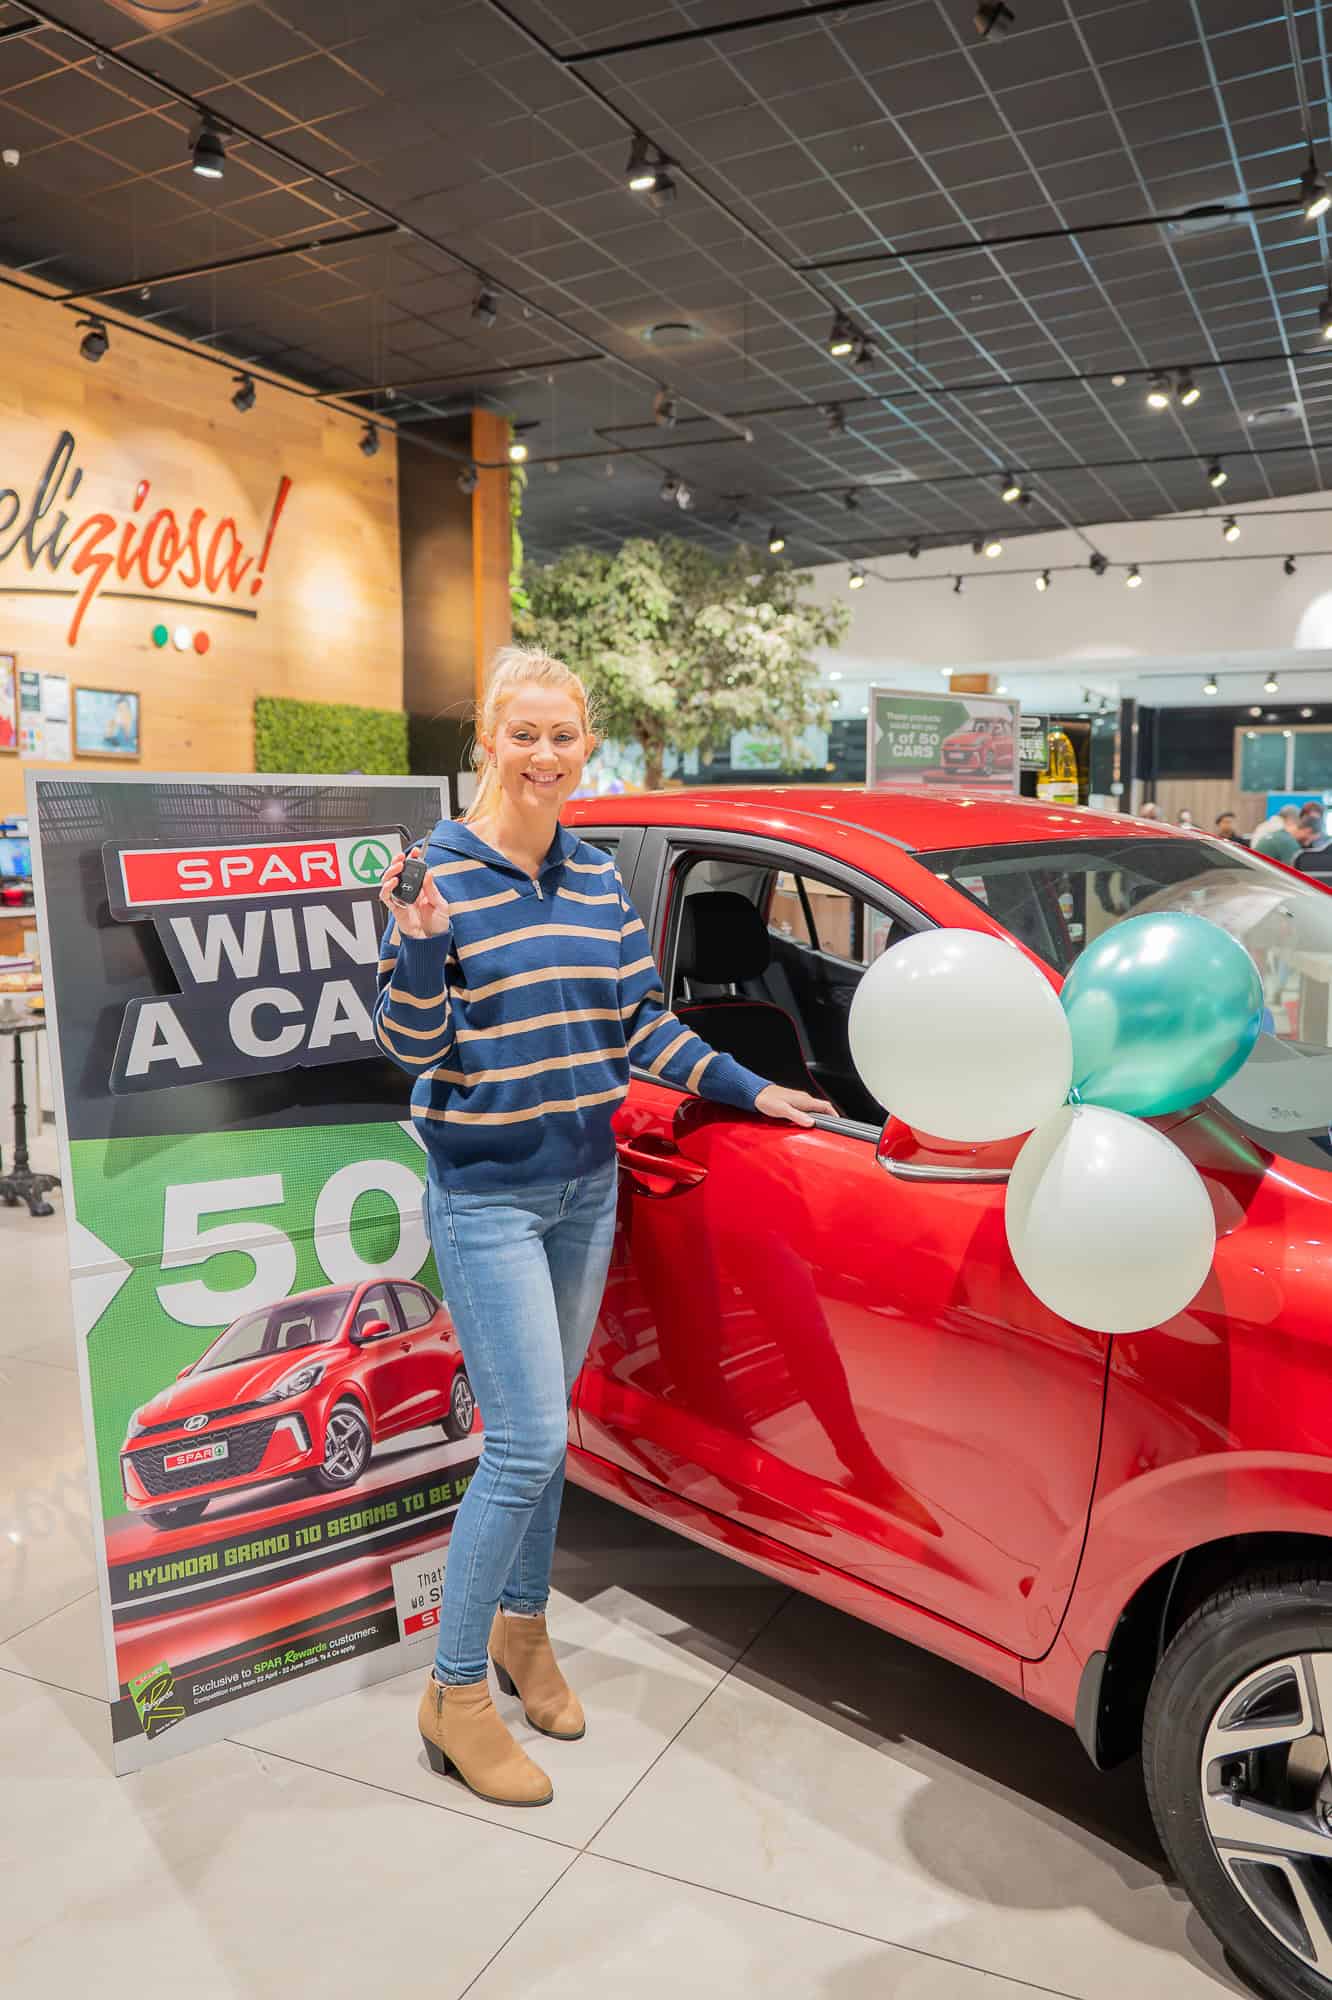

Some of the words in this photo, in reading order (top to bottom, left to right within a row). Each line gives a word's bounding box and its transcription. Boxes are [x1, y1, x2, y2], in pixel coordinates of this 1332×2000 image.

[0, 430, 293, 647] eliziosa!
[892, 745, 934, 758] CARS
[899, 732, 914, 745] of
[176, 851, 337, 891] SPAR
[169, 900, 379, 983] WIN
[125, 1001, 202, 1077] A
[228, 979, 376, 1058] CA
[155, 1159, 432, 1328] 50
[176, 1447, 212, 1465] SPAR
[128, 1551, 219, 1592] HYUNDAI
[224, 1533, 290, 1568] GRAND
[327, 1501, 399, 1538] SEDANS
[402, 1492, 425, 1513] TO
[429, 1483, 451, 1505] BE
[417, 1565, 447, 1588] That'
[192, 1673, 240, 1696] Exclusive
[241, 1668, 252, 1679] to
[254, 1656, 282, 1674] SPAR
[284, 1642, 328, 1664] Rewards
[329, 1625, 379, 1649] customers.
